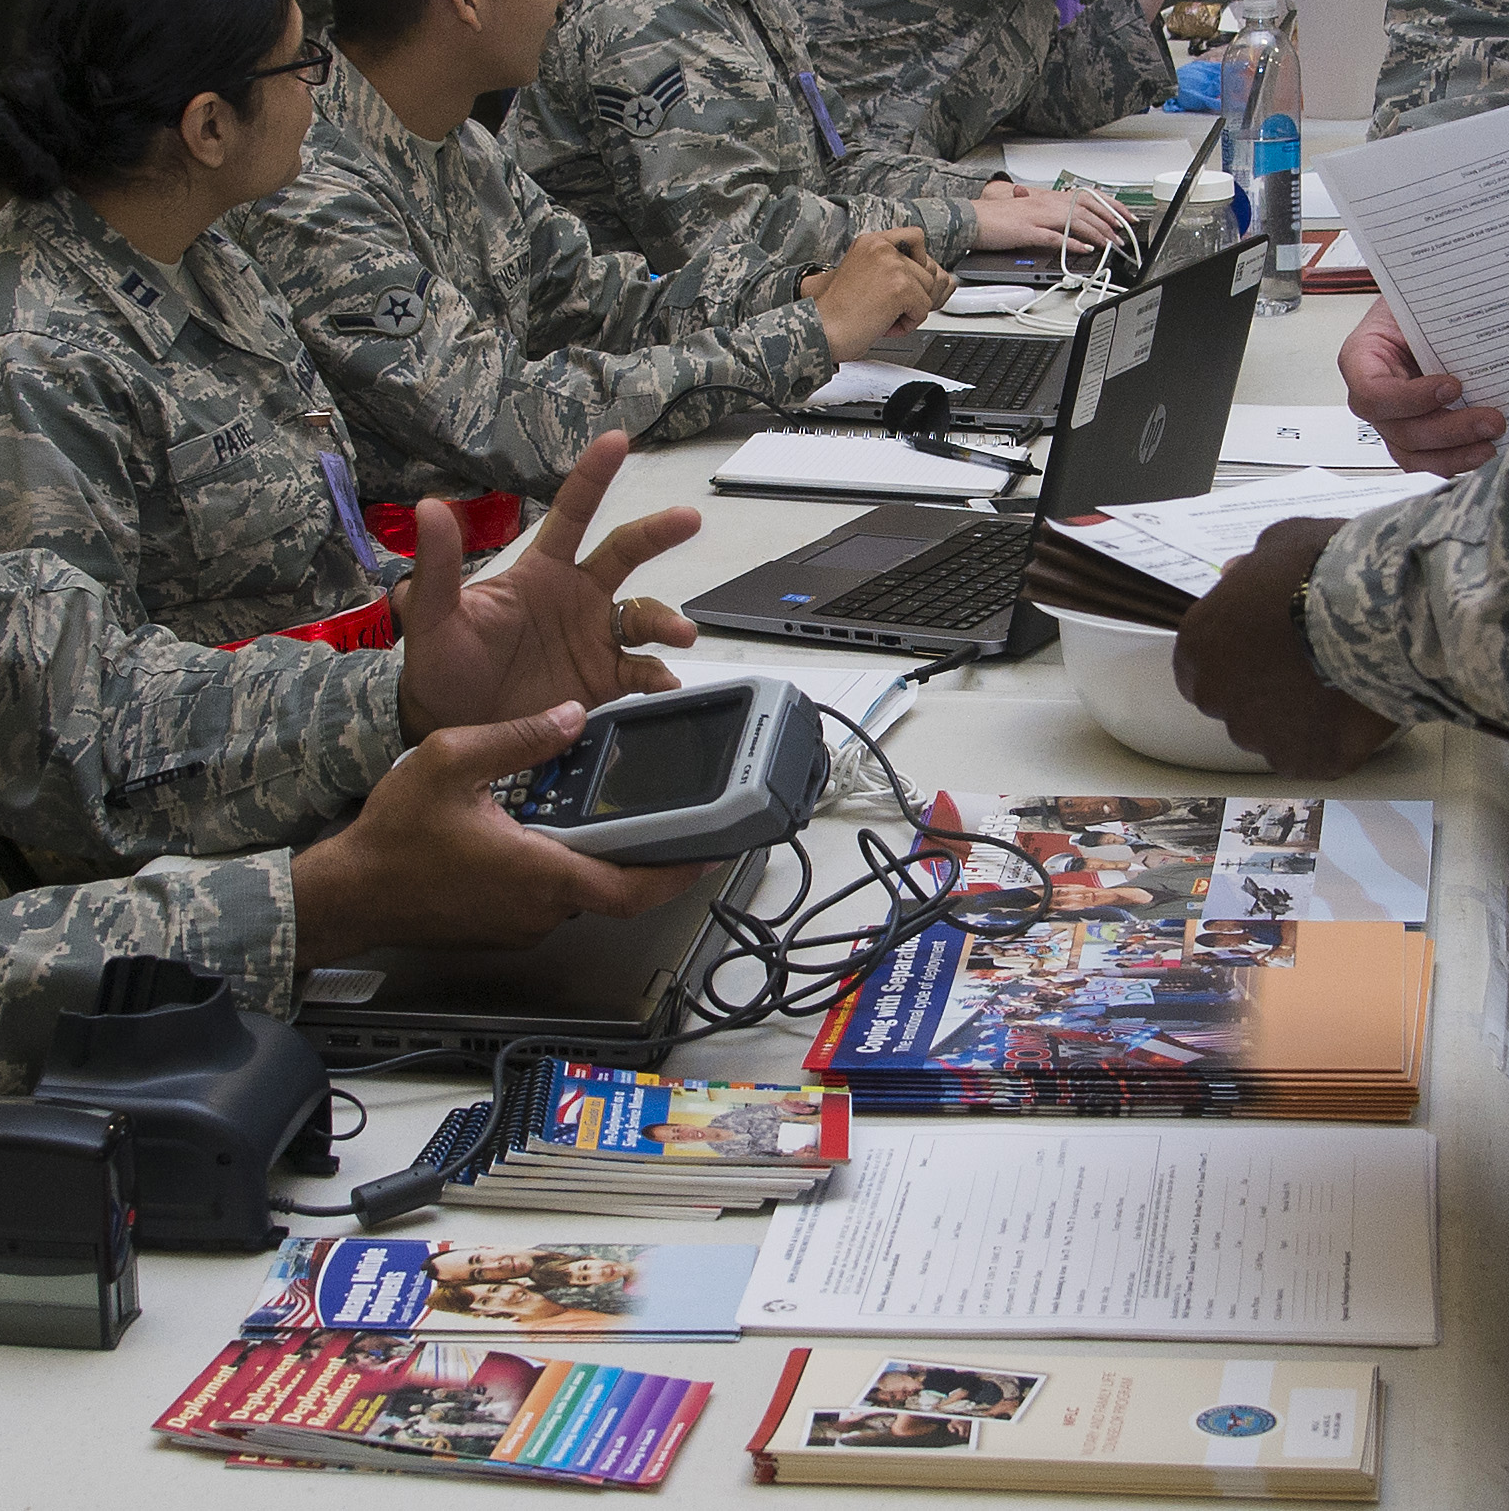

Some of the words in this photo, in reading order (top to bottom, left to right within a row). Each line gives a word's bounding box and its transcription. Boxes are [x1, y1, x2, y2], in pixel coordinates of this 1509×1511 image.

[878, 933, 929, 991] Separatio
[917, 939, 951, 980] deployment
[908, 990, 935, 1008] cycle
[915, 981, 935, 989] of
[870, 994, 903, 1017] with
[897, 1009, 926, 1039] emotional
[854, 1018, 899, 1052] Coping
[892, 1040, 914, 1052] The
[168, 1364, 233, 1429] Deployment
[234, 1352, 301, 1421] Deployment
[279, 1355, 353, 1424] Deployment
[304, 1371, 364, 1427] Readiness
